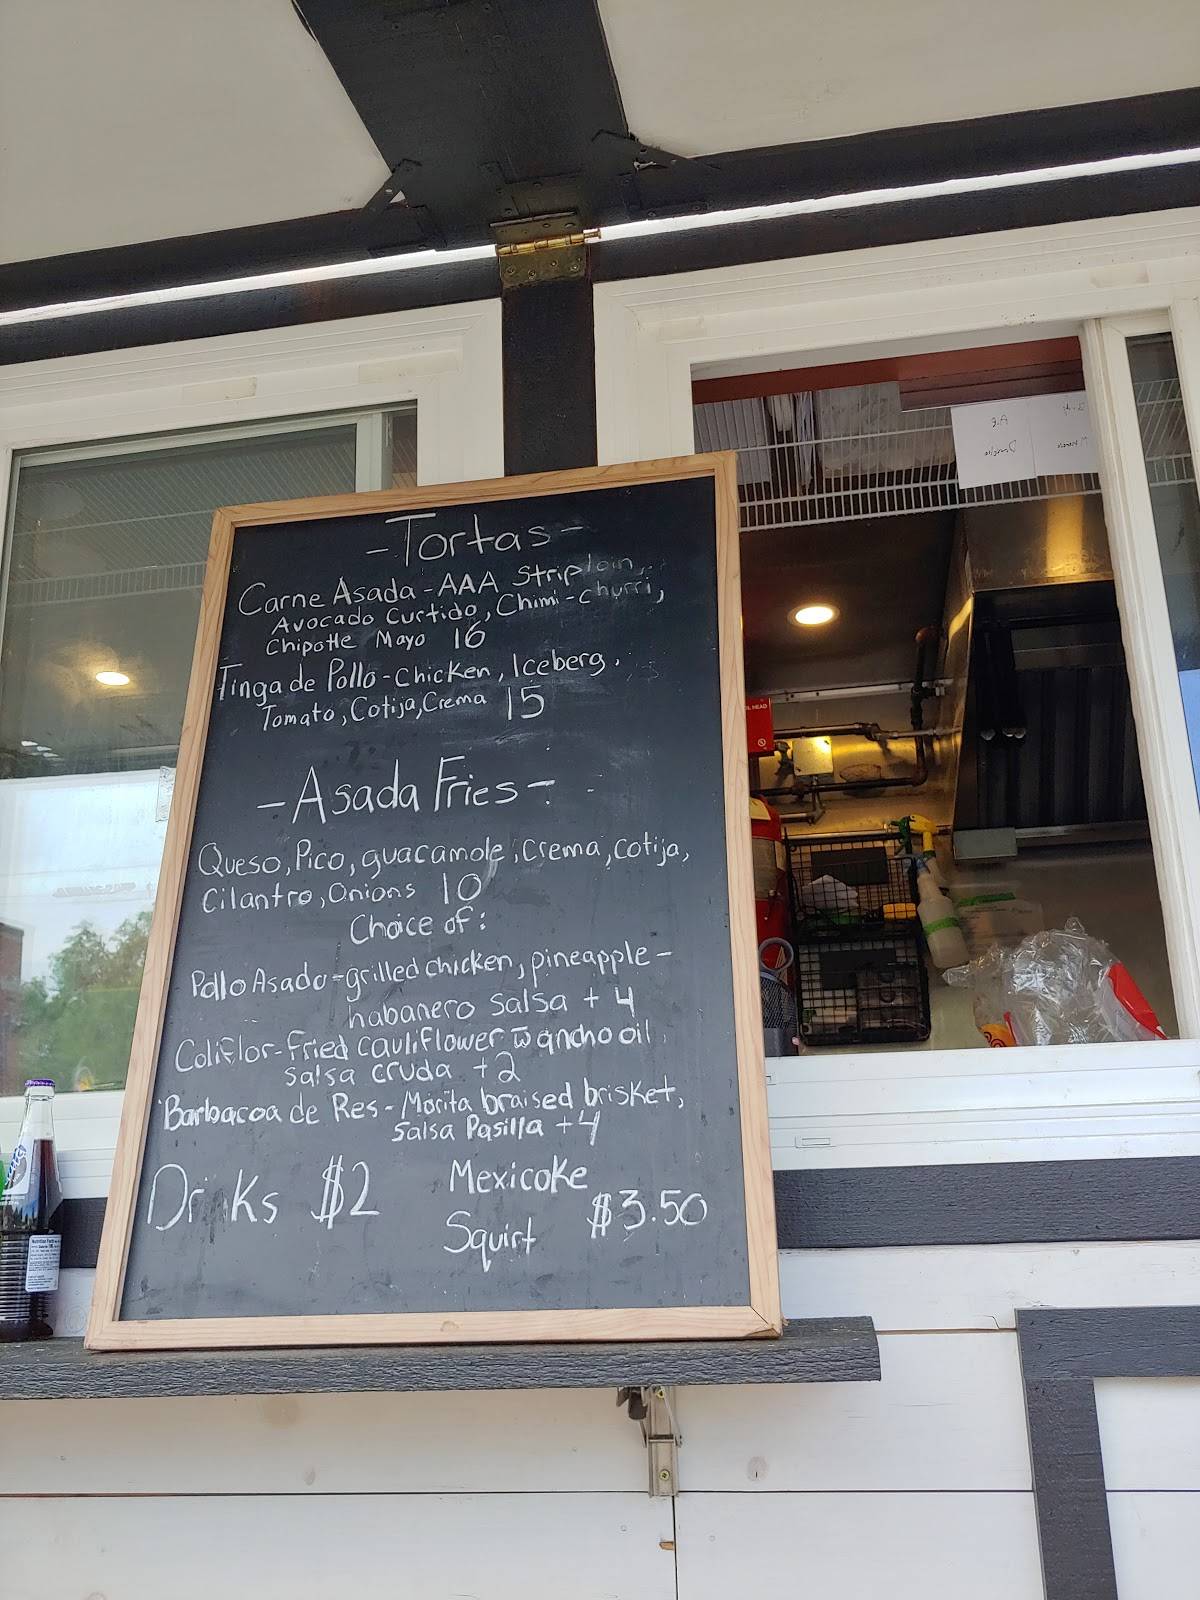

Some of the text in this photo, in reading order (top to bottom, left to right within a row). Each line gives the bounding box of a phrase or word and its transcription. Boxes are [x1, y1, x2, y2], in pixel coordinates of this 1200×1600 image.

[385, 512, 551, 568] Tortas
[238, 581, 326, 616] Carne
[333, 575, 417, 605] Asada
[438, 570, 500, 598] AAA
[266, 619, 487, 657] Chipotle Mayo 16
[271, 605, 375, 636] Avocado
[386, 602, 492, 626] Curtido,
[218, 662, 282, 707] Tinga
[289, 662, 316, 692] de
[327, 657, 377, 692] Pollo
[261, 702, 347, 731] Tomato,
[423, 691, 488, 713] Crema
[507, 684, 545, 721] 15
[291, 758, 420, 826] Asada
[433, 754, 519, 813] Fries
[198, 841, 292, 878] Queso,
[296, 838, 355, 877] Pico,
[328, 881, 416, 904] Onions
[442, 872, 483, 905] 10
[350, 913, 434, 945] Choice
[191, 969, 247, 1001] Pollo
[348, 999, 477, 1030] habanero
[371, 1058, 453, 1084] cruda
[163, 1093, 283, 1132] Barbacoa
[289, 1090, 321, 1126] de
[332, 1091, 379, 1123] Res
[401, 1088, 472, 1120] Morita
[480, 1080, 575, 1116] braised
[466, 1112, 545, 1143] Pasilla
[311, 1153, 382, 1231] $2
[586, 1188, 708, 1240] $3.50
[443, 1209, 537, 1273] Squirt
